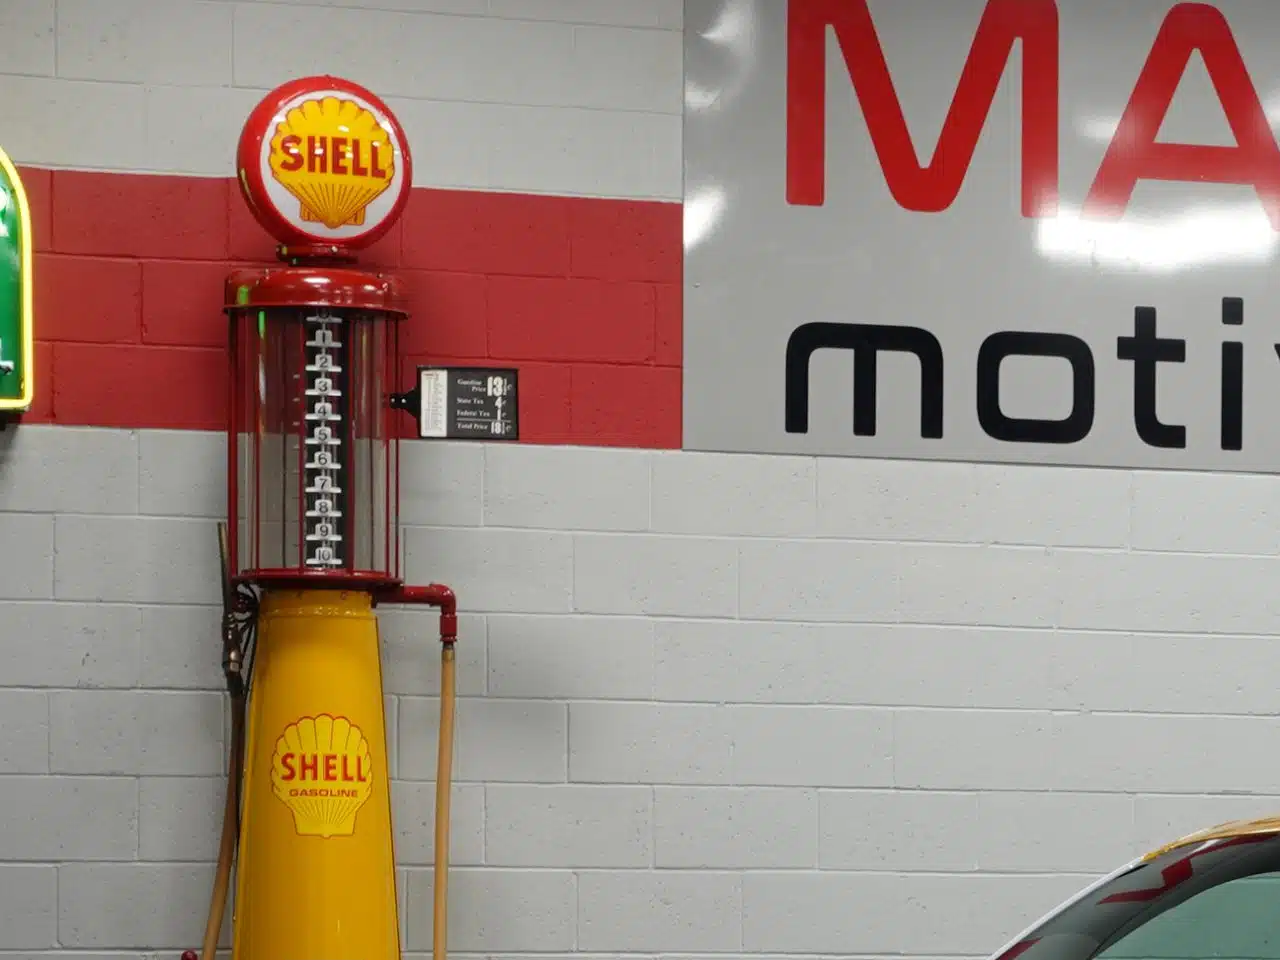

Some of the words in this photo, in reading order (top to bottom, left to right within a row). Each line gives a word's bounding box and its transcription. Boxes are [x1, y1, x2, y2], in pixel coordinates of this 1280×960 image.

[280, 134, 386, 179] SHELL
[319, 356, 328, 368] 2
[318, 380, 328, 392] 3
[318, 404, 327, 416] 4
[318, 429, 327, 440] 5
[318, 453, 327, 465] 6
[319, 478, 327, 490] 7
[319, 501, 328, 513] 8
[319, 525, 328, 536] 9
[318, 550, 330, 561] 10
[281, 753, 366, 782] SHELL
[289, 788, 358, 797] GASOLINE
